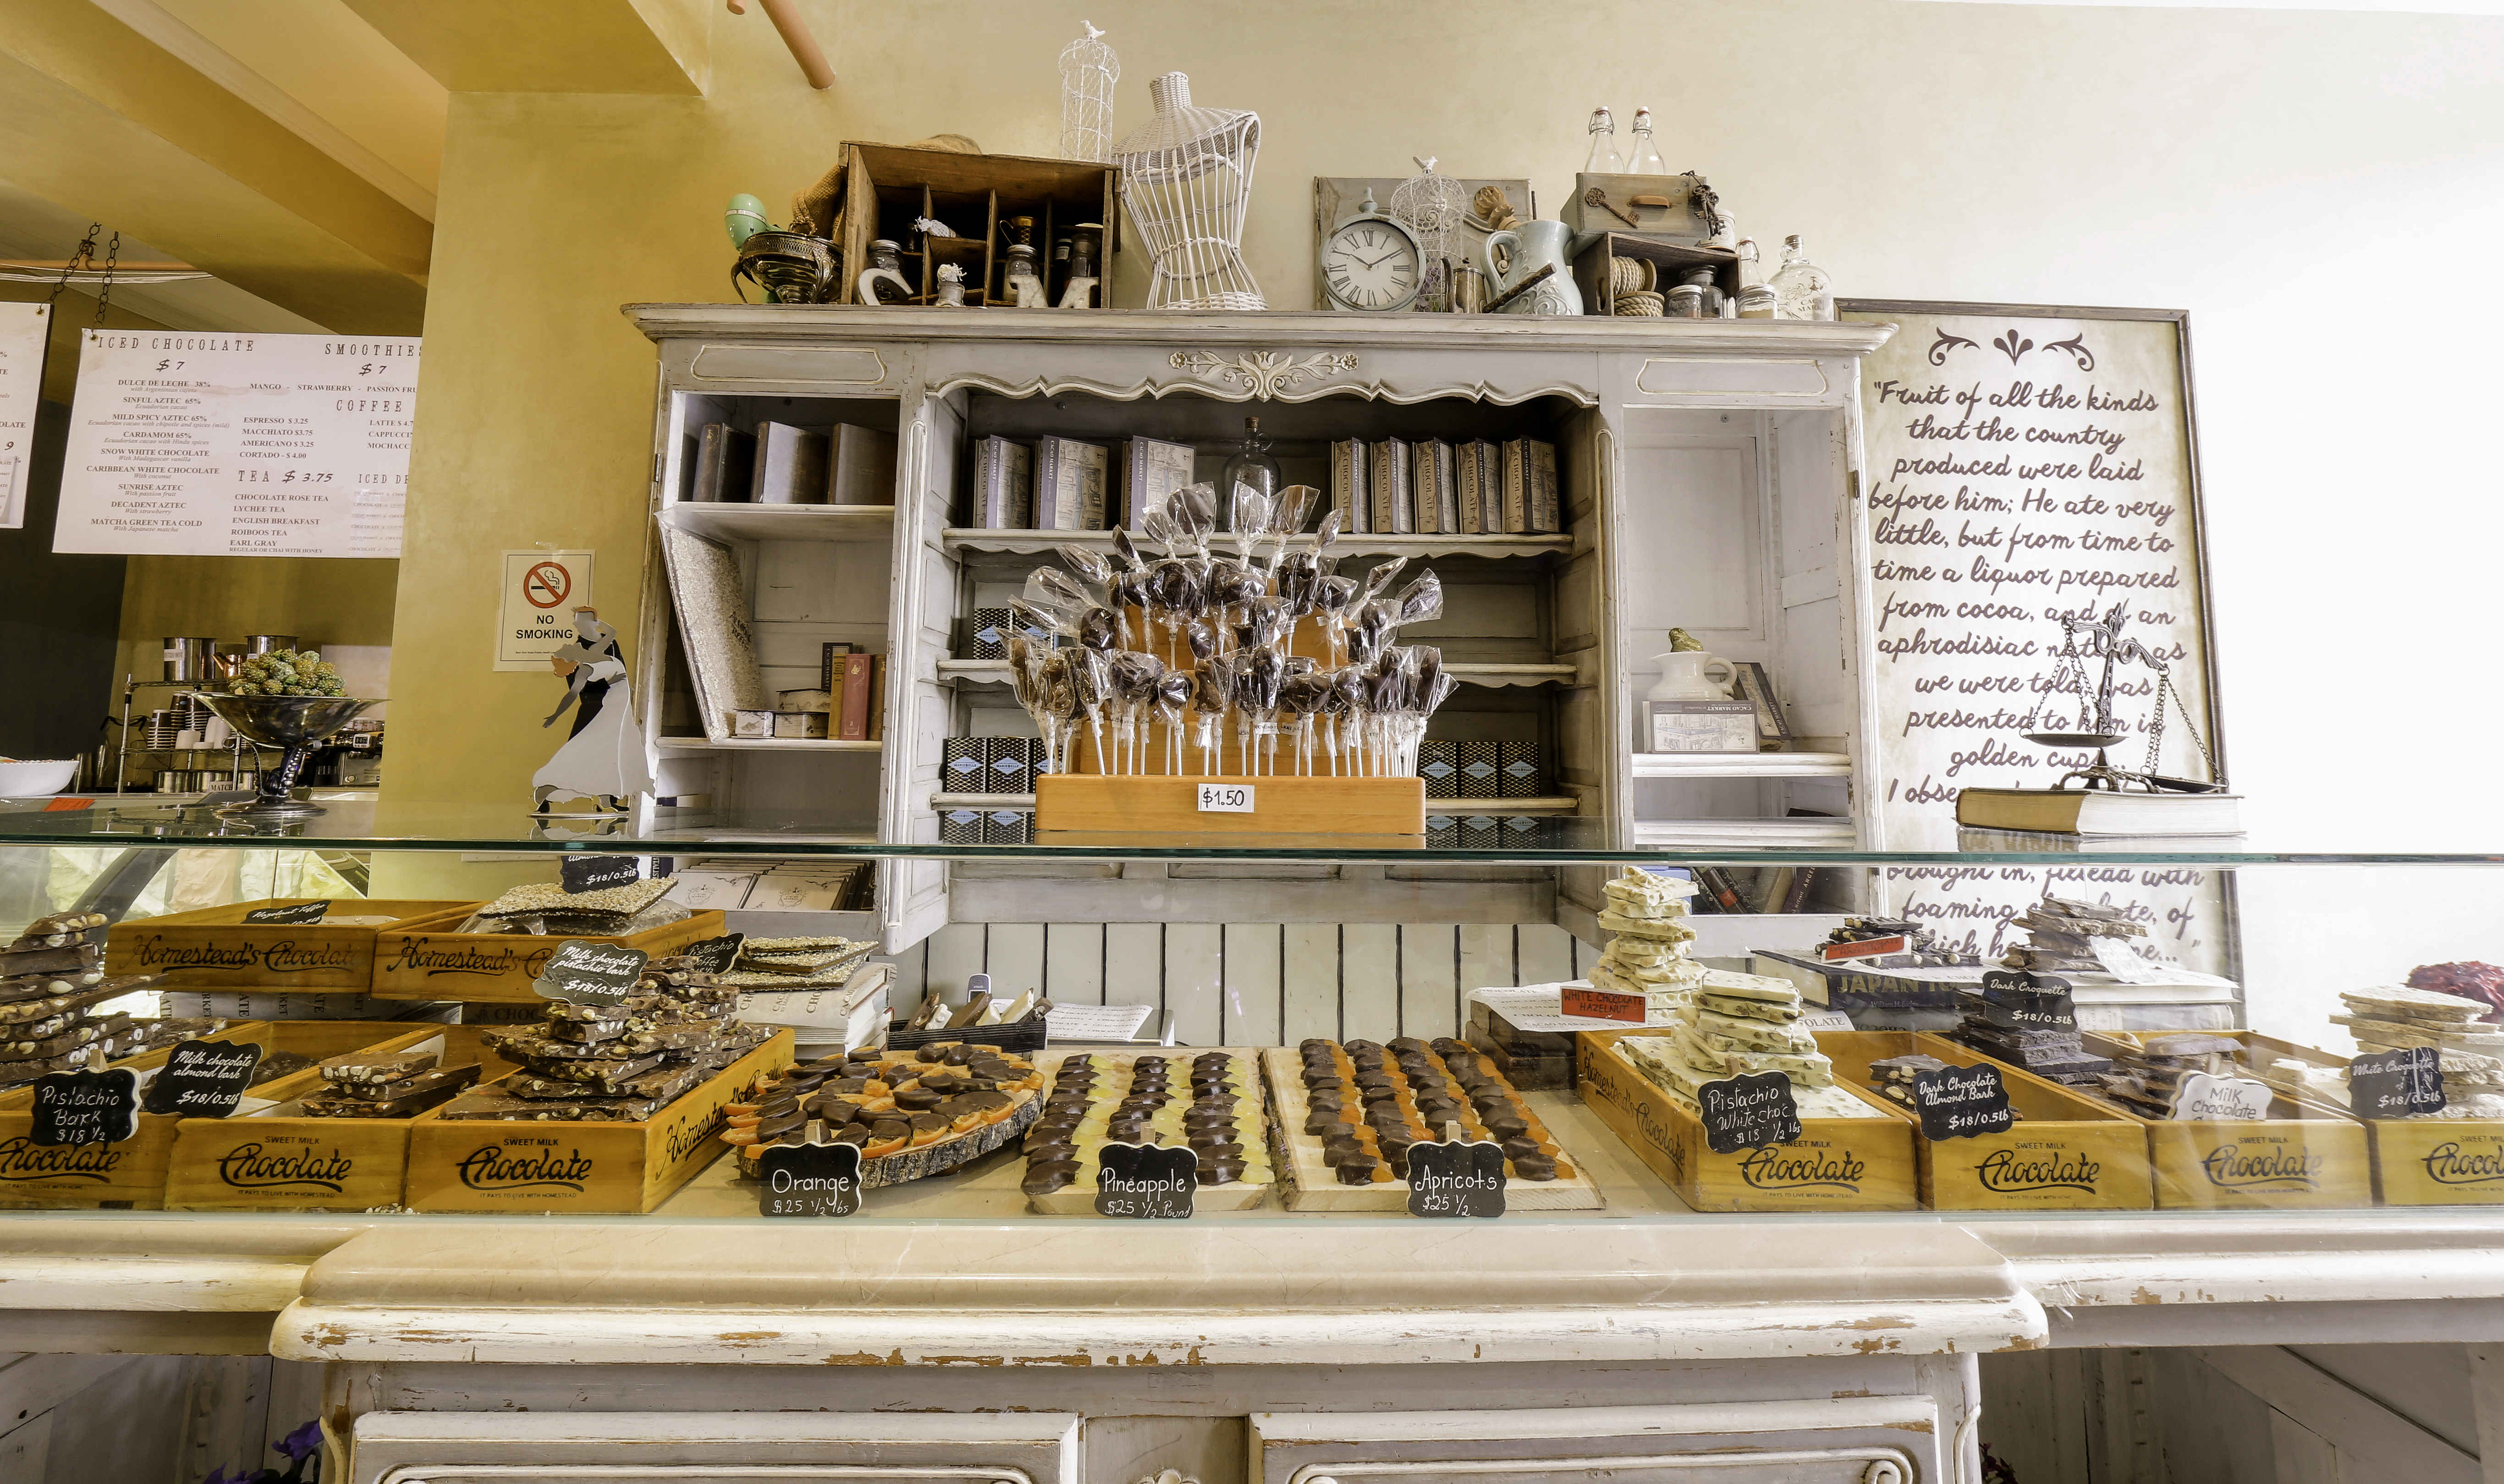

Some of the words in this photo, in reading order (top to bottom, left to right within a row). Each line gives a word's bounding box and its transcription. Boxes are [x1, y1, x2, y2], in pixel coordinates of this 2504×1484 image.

[99, 337, 138, 348] ICED
[152, 338, 253, 351] CHOCOLATE
[336, 400, 402, 412] COFFEE
[1956, 381, 1982, 420] of
[1989, 380, 2033, 407] all
[2035, 384, 2080, 409] the
[2086, 385, 2159, 412] kinds
[1905, 414, 1971, 440] that
[1972, 416, 2019, 441] the
[2025, 424, 2125, 455] country
[238, 471, 270, 482] TEA
[1890, 452, 2012, 483] produced
[2018, 462, 2082, 480] were
[2088, 453, 2144, 481] laid
[1869, 481, 1949, 524] before
[1954, 484, 2013, 515] him;
[2021, 488, 2057, 513] He
[2064, 493, 2109, 515] ate
[2114, 501, 2175, 527] very
[1874, 518, 1949, 549] little,
[1957, 519, 2003, 548] but
[2006, 522, 2075, 562] from
[2078, 527, 2145, 550] time
[2145, 527, 2174, 553] to
[1871, 559, 1937, 582] time
[1942, 567, 1963, 582] a
[1970, 555, 2053, 595] liquor
[2056, 566, 2180, 595] prepared
[537, 616, 554, 624] NO
[1878, 591, 1950, 632] from
[1956, 601, 2034, 621] cocoa,
[516, 630, 573, 639] SMOKING
[1878, 627, 2039, 663] aphrodisiac
[1915, 676, 1954, 693] we
[1958, 677, 2023, 694] were
[1902, 705, 2036, 737] presented
[2039, 712, 2070, 731] to
[1946, 737, 2040, 777] golden
[1203, 787, 1244, 808] $1.50
[1901, 890, 2018, 930] foaming
[120, 934, 261, 973] Homestead's
[561, 946, 593, 961] Milk
[591, 952, 640, 967] chocolate
[552, 960, 605, 972] pistachio
[605, 964, 632, 976] bark
[1563, 990, 1593, 1001] WHITE
[1596, 993, 1643, 1005] CHOCOLATE
[1990, 979, 2016, 991] Dark
[2018, 982, 2069, 996] Croquette
[1580, 1002, 1628, 1013] HAZELNUT
[2012, 1009, 2072, 1025] $18/0.5lb
[174, 1050, 206, 1065] Milk
[206, 1053, 253, 1067] chocolate
[2353, 1062, 2383, 1076] White
[173, 1064, 217, 1077] almond
[218, 1066, 242, 1079] bark
[1919, 1081, 1945, 1095] Dark
[1947, 1072, 1998, 1092] Chocolate
[1969, 1087, 1996, 1100] Bark
[176, 1090, 241, 1105] $18/0.5lb
[1707, 1083, 1779, 1113] Pistachio
[1717, 1107, 1755, 1131] White
[2192, 1100, 2256, 1119] Chocolate
[1948, 1110, 2009, 1131] $18/0.5lb
[265, 1136, 295, 1144] SWEET
[217, 1143, 352, 1192] Chocolate
[457, 1146, 592, 1192] Chocolate
[1737, 1147, 1864, 1193] Chocolate
[1975, 1150, 2100, 1194] Chocolate
[2201, 1144, 2322, 1187] Chocolate
[772, 1169, 850, 1206] Orange
[1101, 1167, 1186, 1202] Pineapple
[1415, 1165, 1497, 1199] Apricots
[772, 1199, 803, 1215] $25
[1105, 1200, 1134, 1216] $25
[1423, 1194, 1449, 1211] $25
